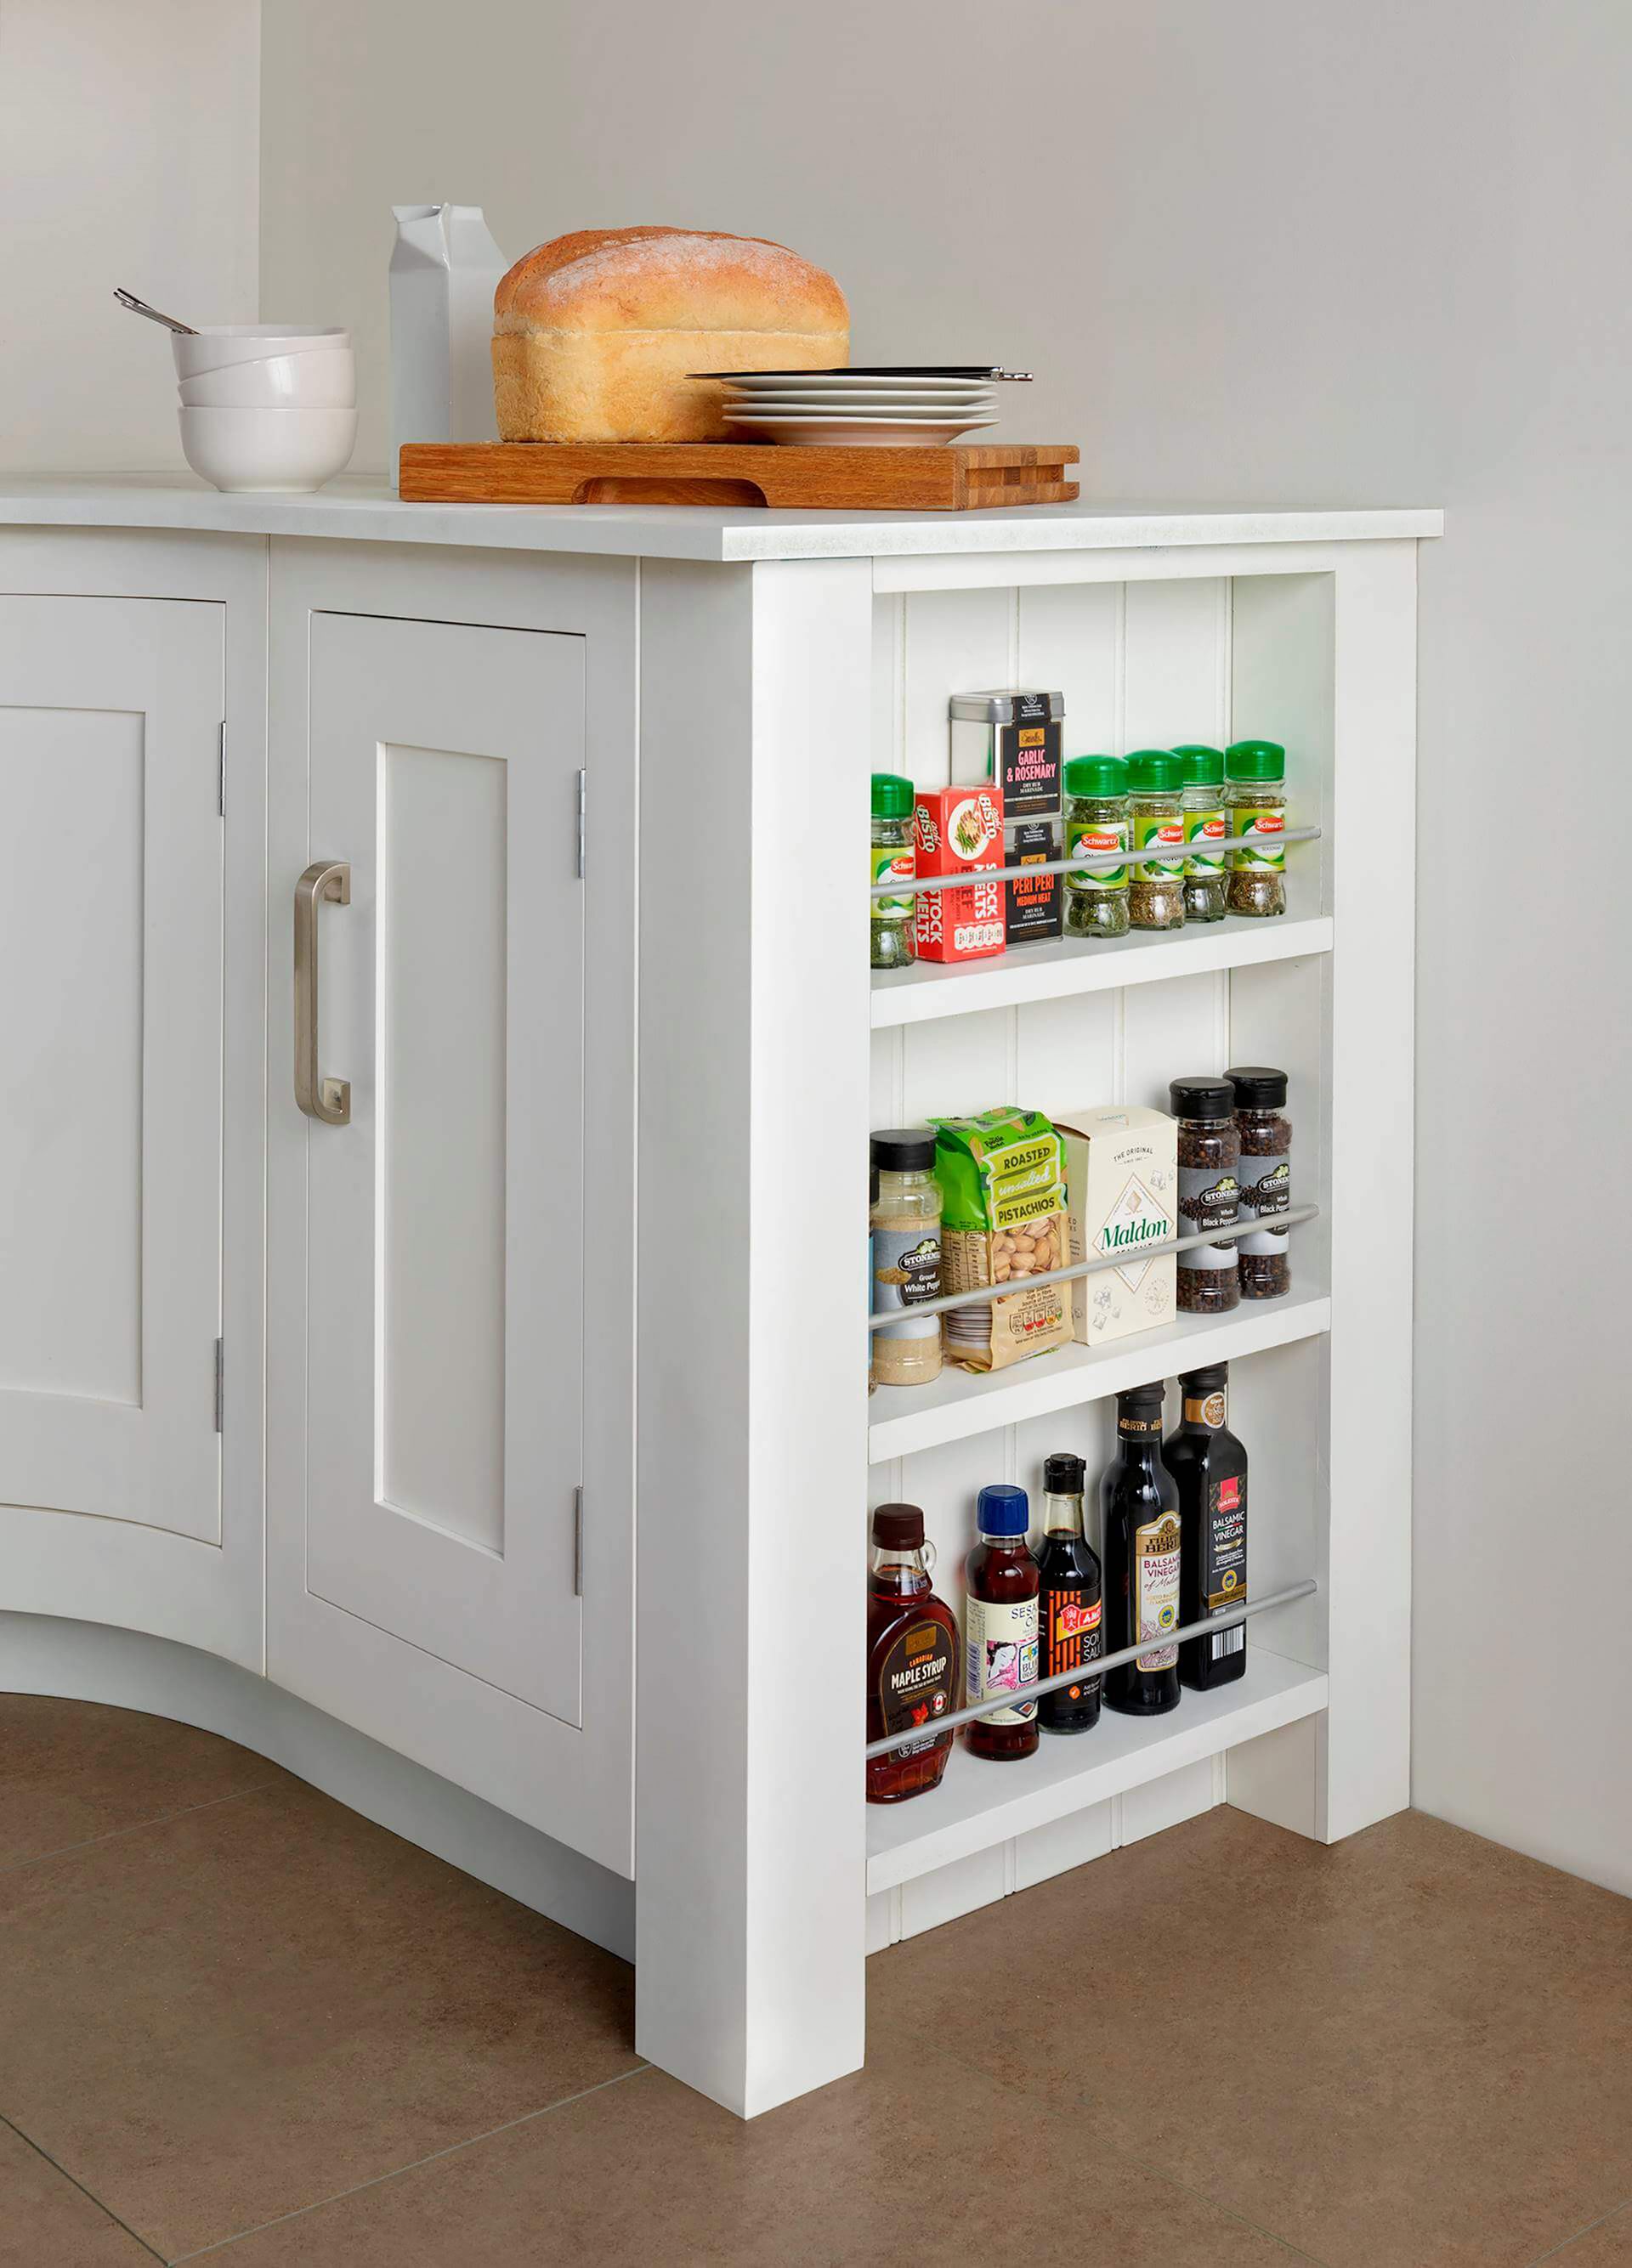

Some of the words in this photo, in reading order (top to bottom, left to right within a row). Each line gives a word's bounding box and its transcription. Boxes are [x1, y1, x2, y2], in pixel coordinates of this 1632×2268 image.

[1018, 749, 1046, 766] GARLIC
[1006, 767, 1013, 783] &
[1015, 763, 1057, 782] ROSEMARY
[978, 796, 997, 840] BISTO
[916, 806, 936, 853] BISTO
[1082, 836, 1118, 846] Schwartz
[986, 863, 999, 918] SOCK
[1012, 876, 1033, 896] PERI
[1034, 873, 1054, 892] PERI
[1017, 895, 1037, 907] MEDIUM
[1038, 892, 1051, 902] HEAT
[1004, 1147, 1051, 1169] ROASTED
[1114, 1151, 1125, 1162] THE
[1126, 1146, 1153, 1157] ORIGINAL
[999, 1165, 1051, 1196] unsalted
[998, 1196, 1055, 1223] PISTACHIOS
[1260, 1204, 1276, 1213] Black
[1203, 1217, 1219, 1226] Black
[1101, 1218, 1167, 1251] Maldon
[904, 1283, 926, 1292] White
[1212, 1511, 1245, 1530] BALSAMIC
[1214, 1525, 1244, 1541] VINEGAR
[1144, 1580, 1156, 1592] of
[910, 1653, 933, 1667] CANADIAN
[892, 1666, 921, 1690] MAPLE
[921, 1656, 947, 1680] SYRUP
